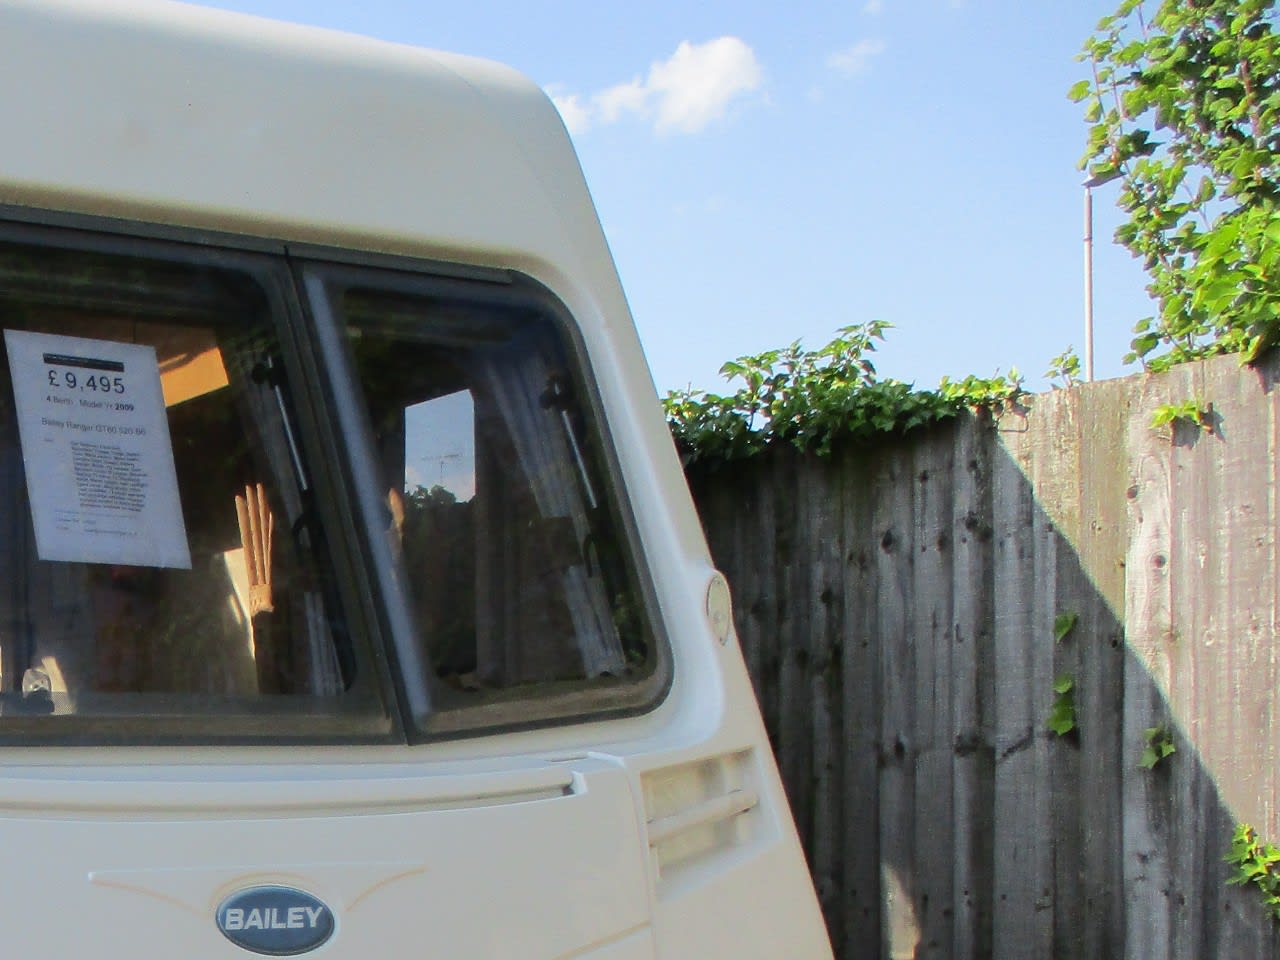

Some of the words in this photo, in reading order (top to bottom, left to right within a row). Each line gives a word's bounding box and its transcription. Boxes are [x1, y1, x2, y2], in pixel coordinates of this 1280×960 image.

[79, 399, 102, 409] Model
[114, 403, 135, 412] 2009
[224, 906, 323, 931] BAILEY
